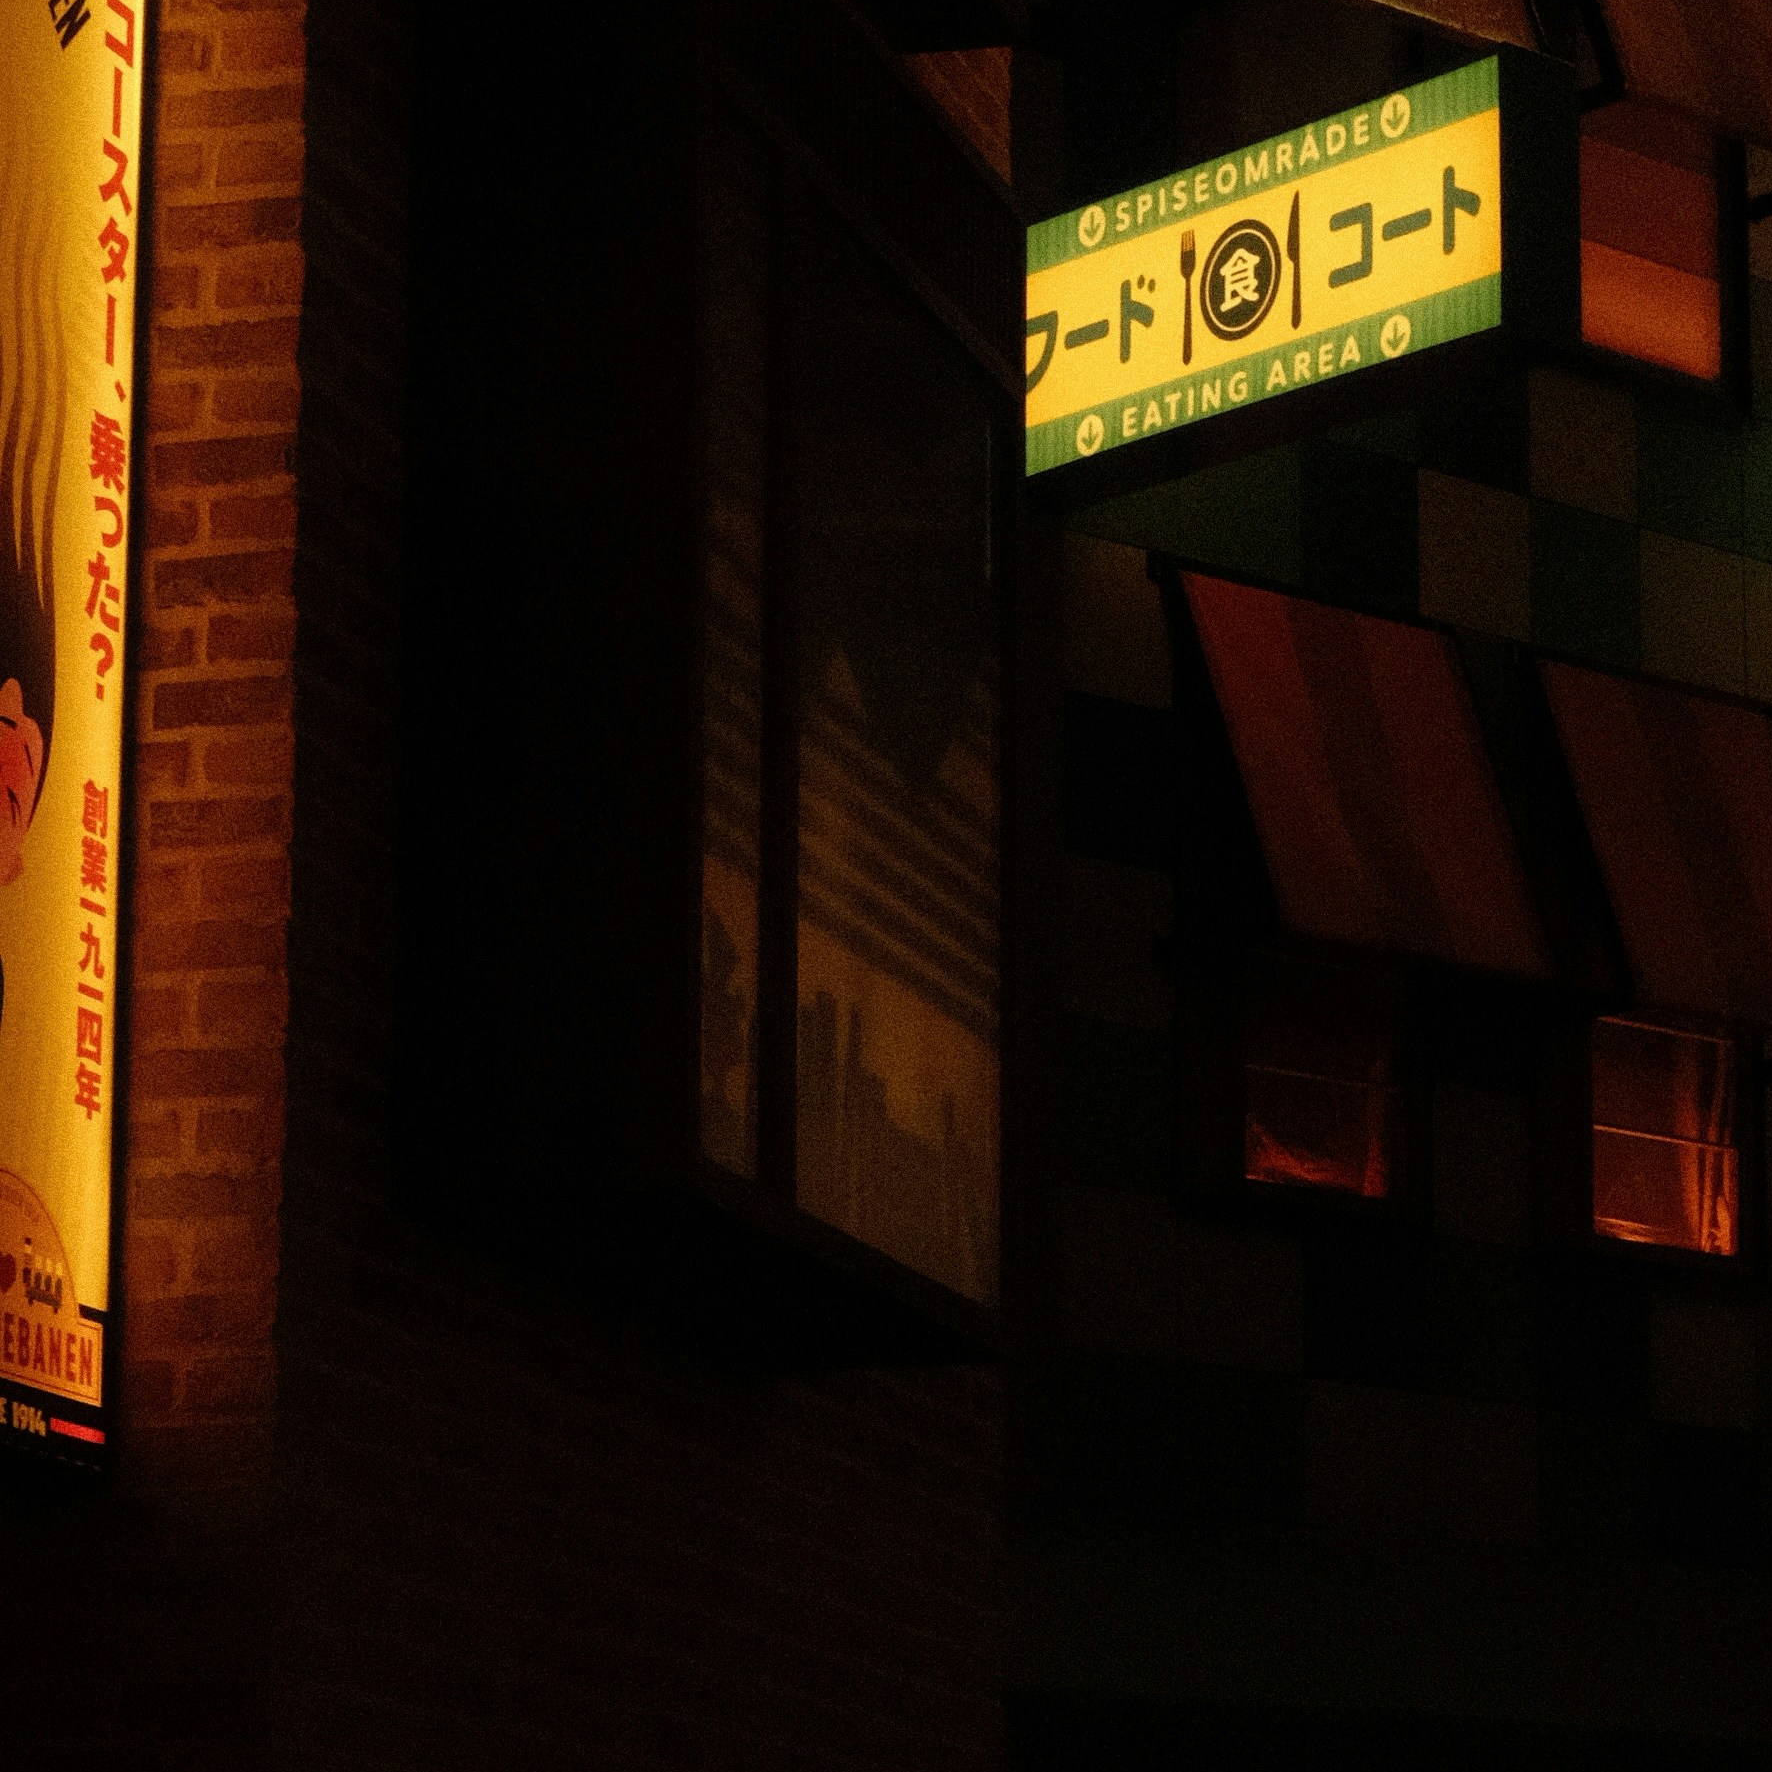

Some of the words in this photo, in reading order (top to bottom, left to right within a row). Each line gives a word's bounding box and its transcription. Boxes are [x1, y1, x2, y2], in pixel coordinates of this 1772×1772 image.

[1116, 113, 1371, 232] SPISEOMRÅDE
[1026, 274, 1156, 394] フード
[1219, 247, 1258, 312] 食
[1329, 165, 1481, 289] コート
[1122, 370, 1248, 437] EATING
[1266, 335, 1361, 391] AREA
